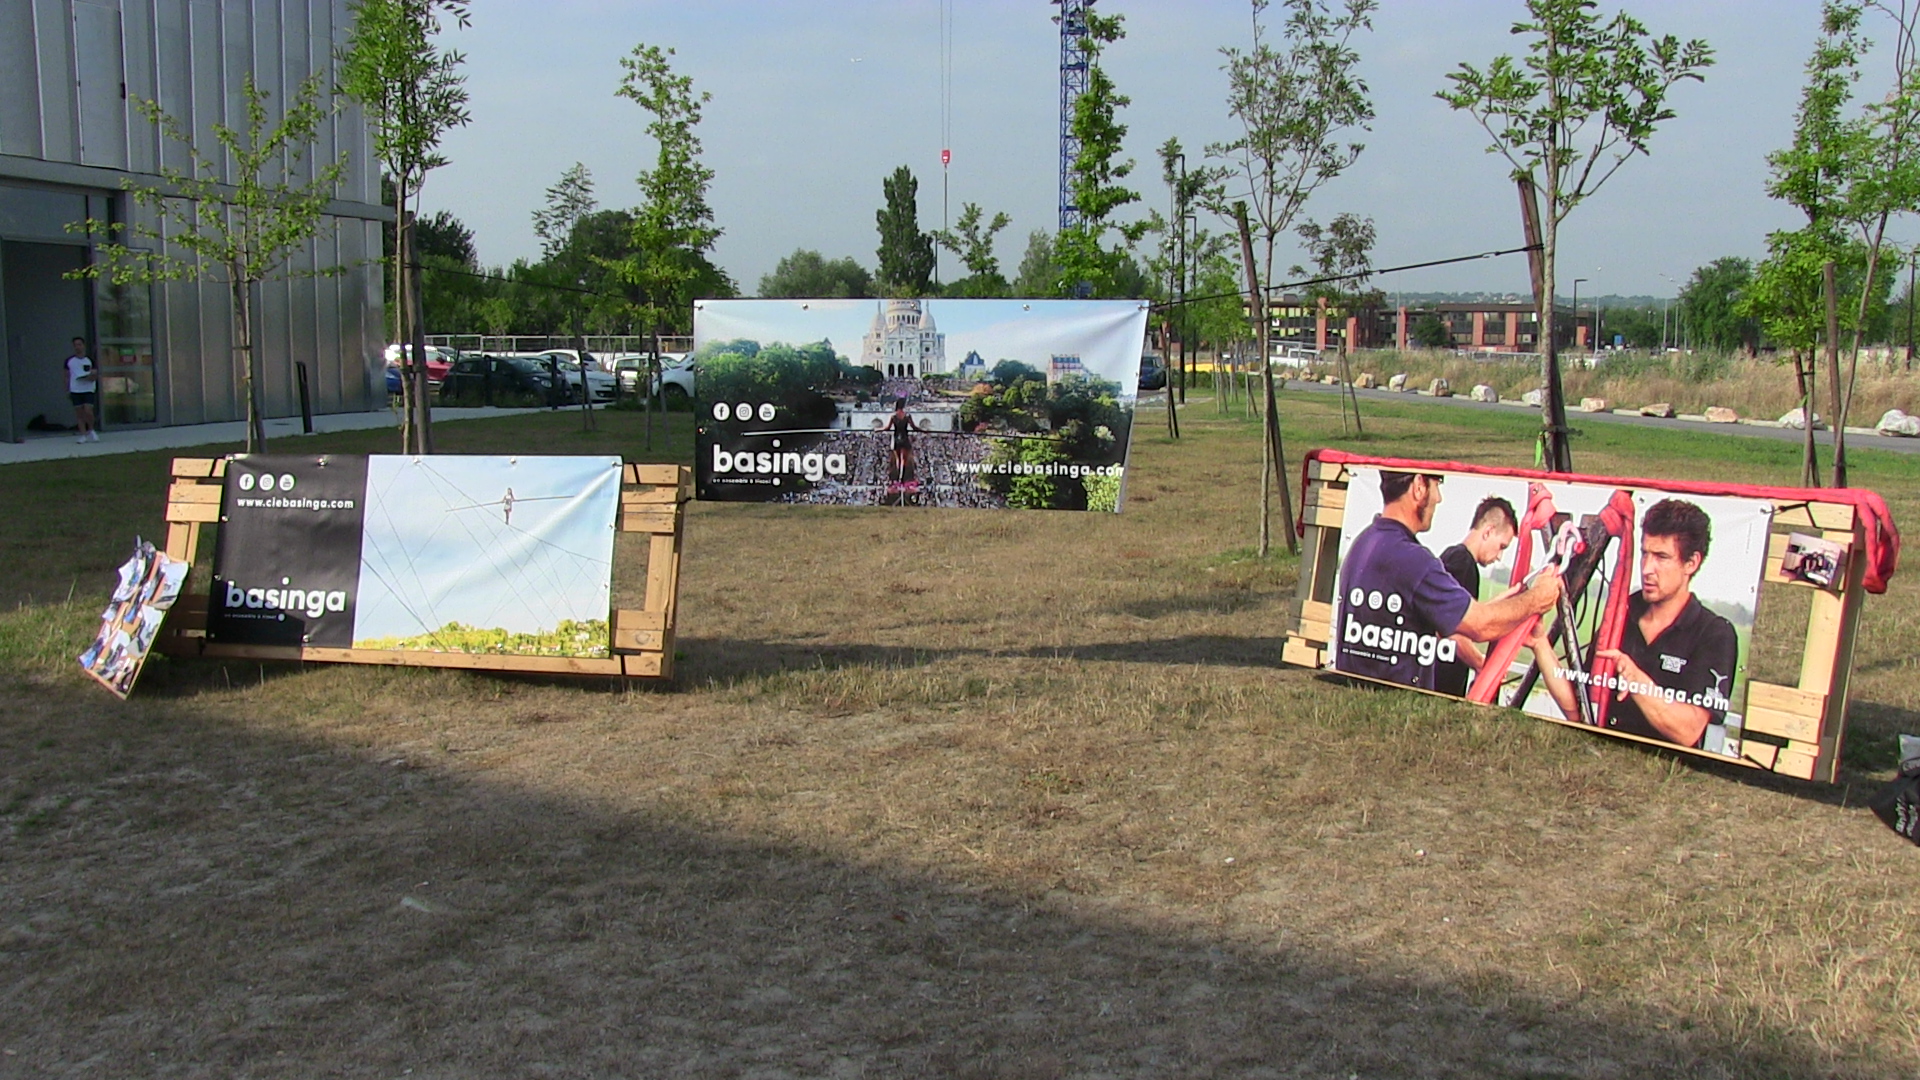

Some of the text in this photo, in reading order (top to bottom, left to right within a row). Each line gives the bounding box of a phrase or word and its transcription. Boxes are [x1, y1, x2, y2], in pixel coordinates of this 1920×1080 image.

[713, 439, 847, 482] basinga
[237, 497, 354, 511] www.ciebasinga.com
[225, 577, 346, 618] basinga
[1344, 613, 1457, 666] basinga
[1553, 666, 1729, 711] www.ciebasinga.com
